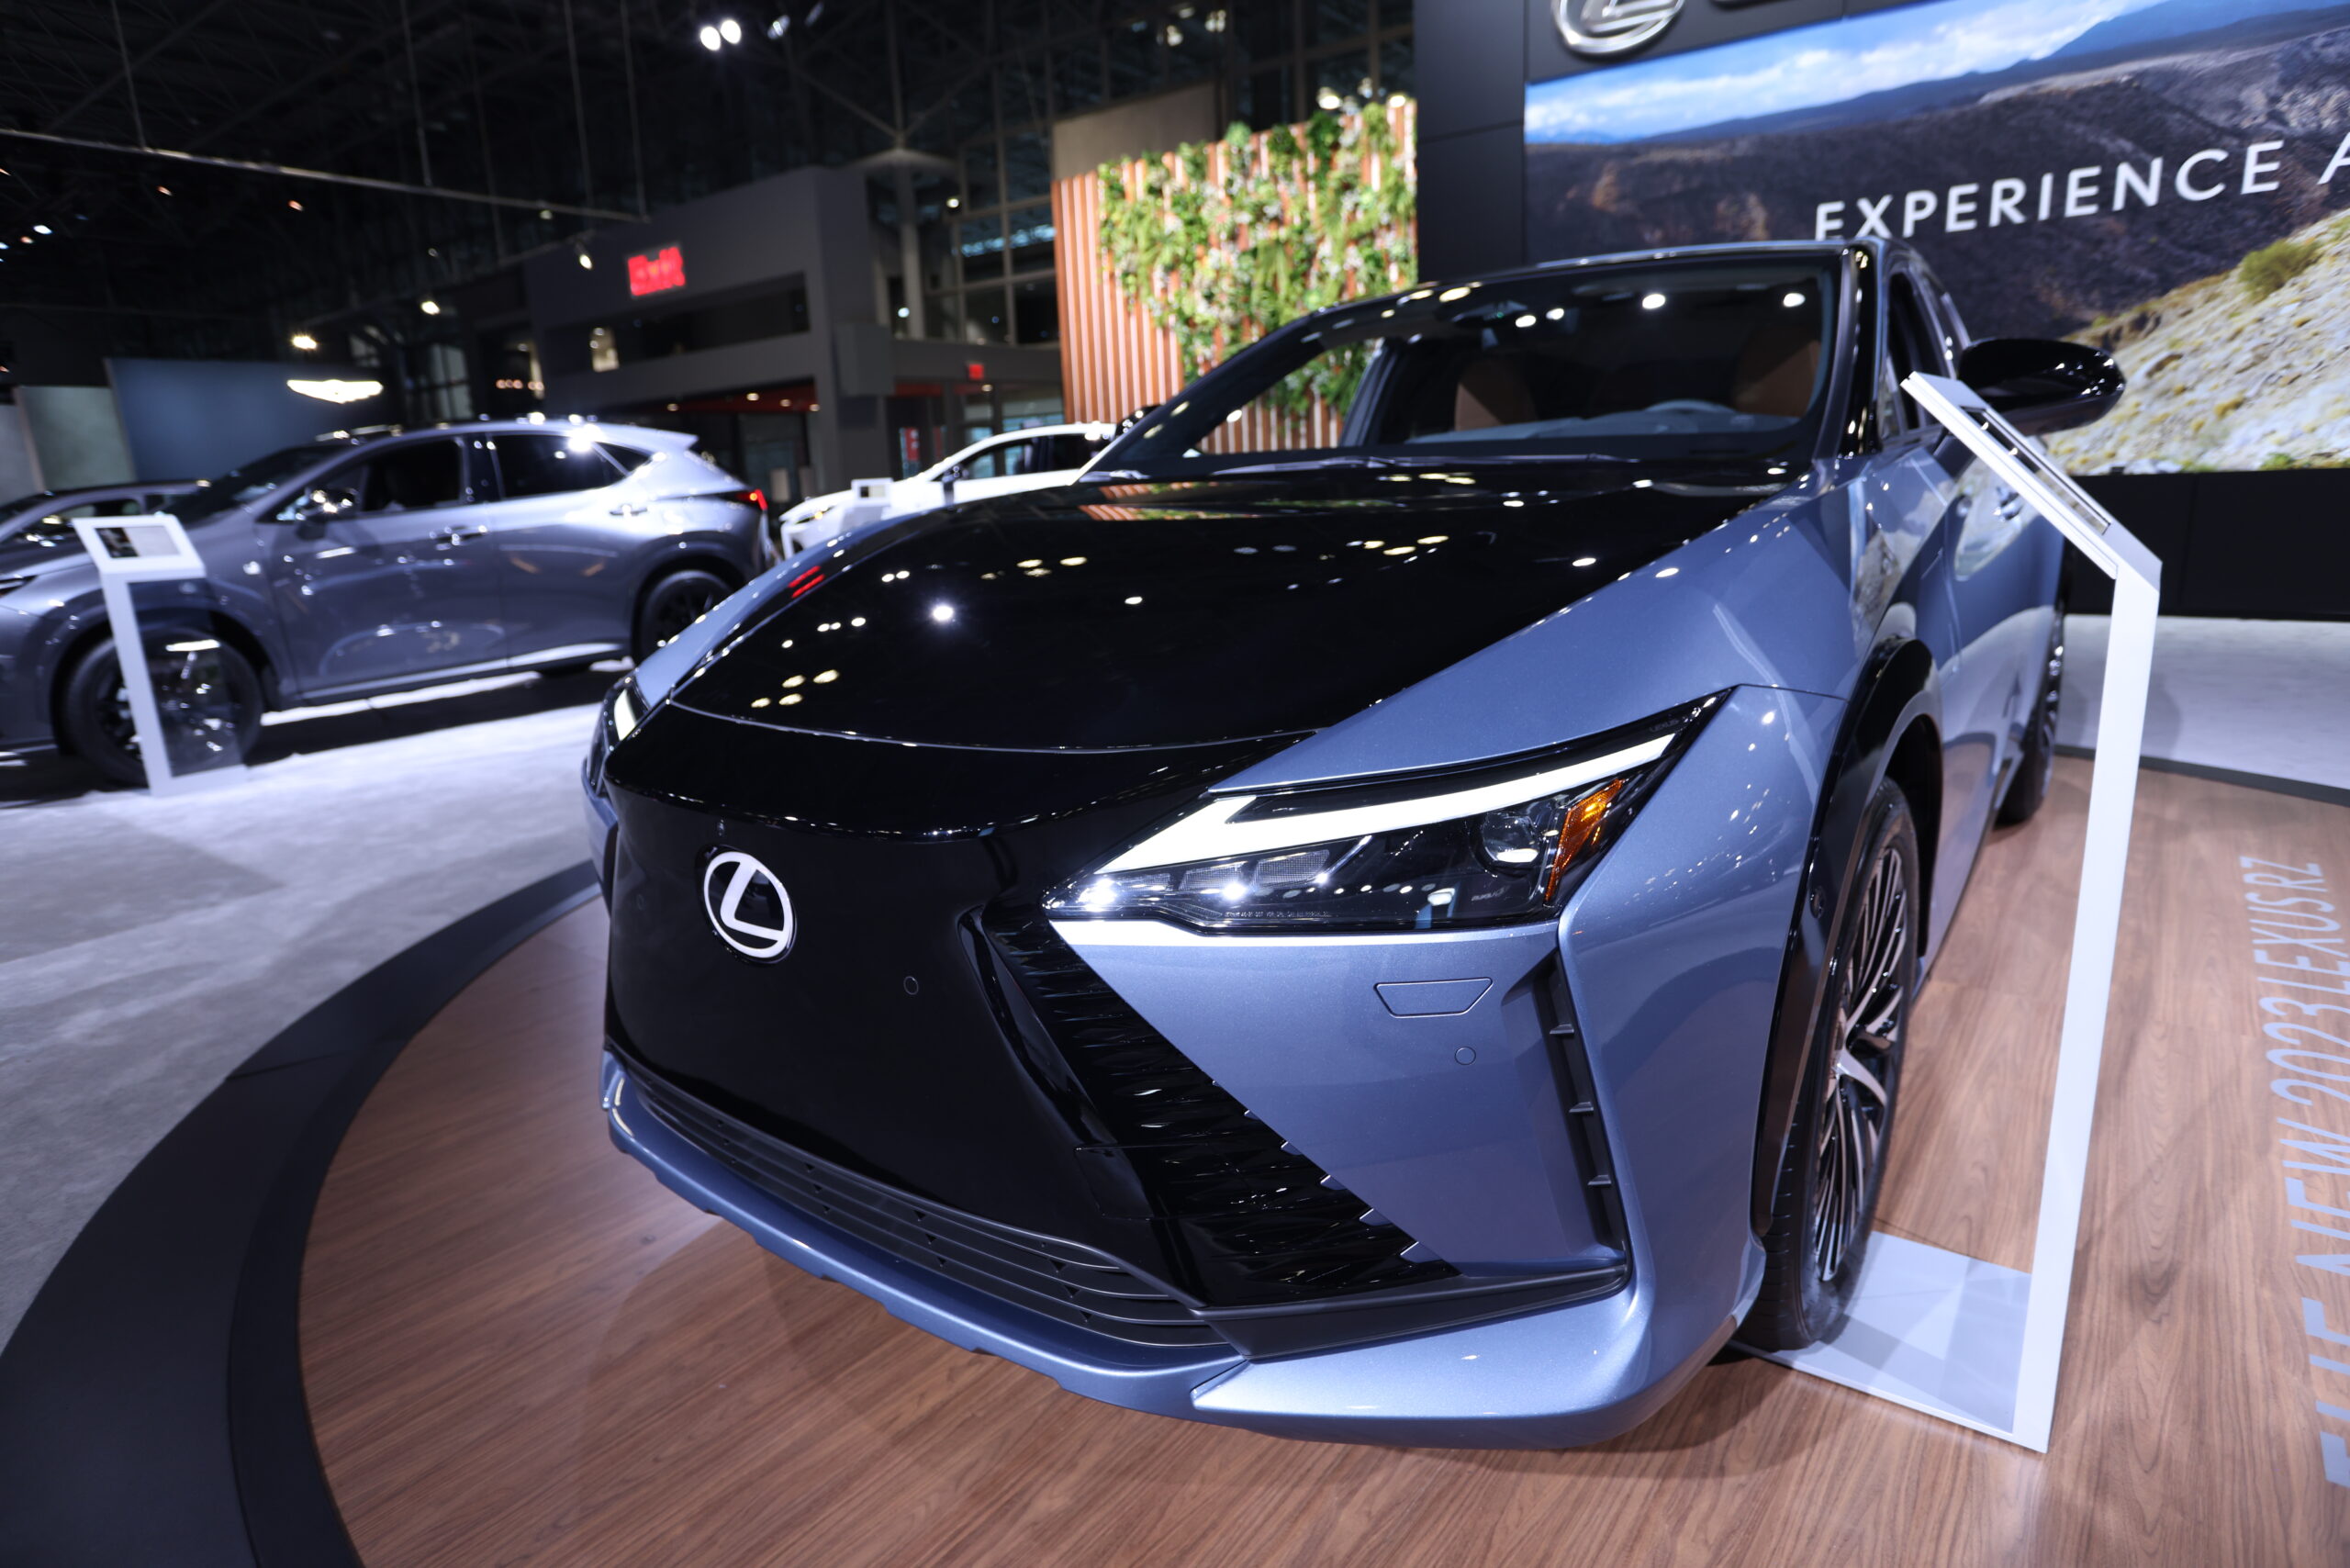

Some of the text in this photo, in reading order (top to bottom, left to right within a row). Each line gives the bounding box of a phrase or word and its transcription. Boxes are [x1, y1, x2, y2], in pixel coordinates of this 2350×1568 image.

[1815, 140, 2284, 241] EXPERIENCE
[2240, 856, 2328, 891] RZ
[2244, 892, 2350, 995] LEXUS
[2258, 997, 2350, 1105] 2023
